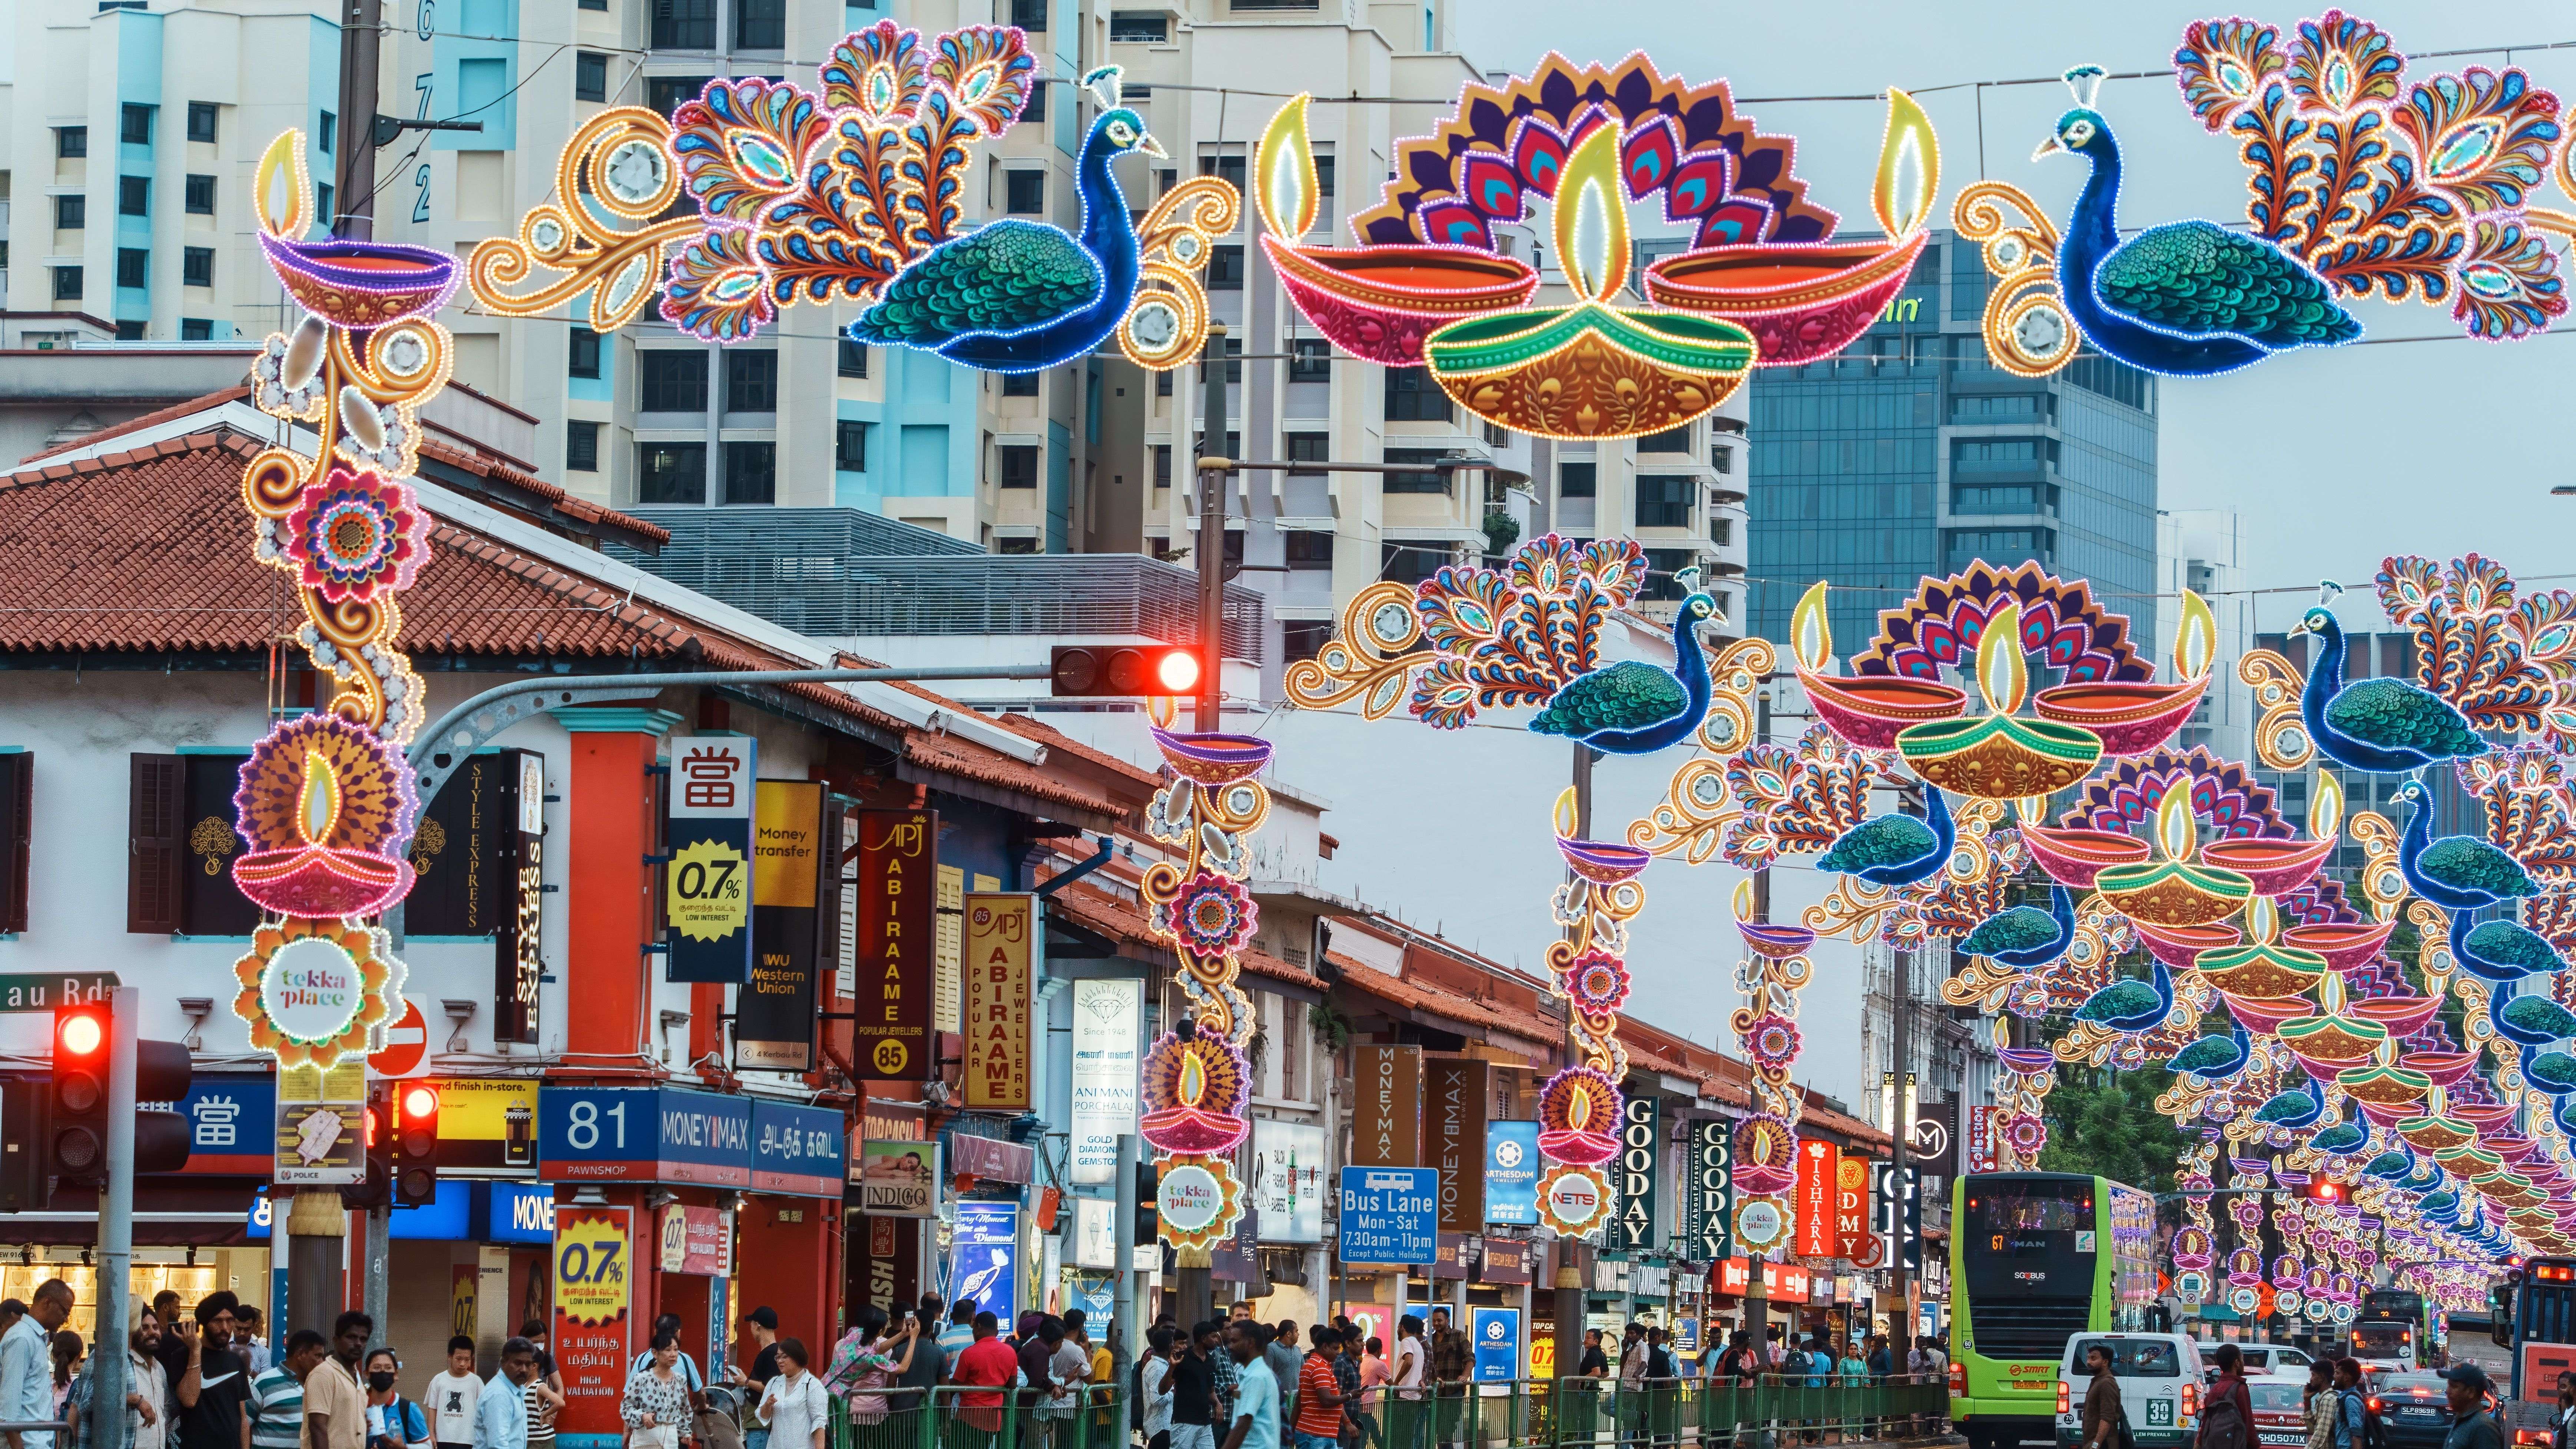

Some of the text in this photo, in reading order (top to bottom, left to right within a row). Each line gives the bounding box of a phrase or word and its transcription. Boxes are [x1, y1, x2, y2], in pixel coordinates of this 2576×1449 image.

[682, 746, 740, 807] 當
[470, 763, 482, 830] STYLE
[759, 827, 806, 840] Money
[755, 845, 810, 857] transfer
[468, 835, 481, 928] EXPRESS
[975, 910, 988, 922] 85
[517, 868, 530, 1003] STYLE
[527, 841, 541, 1032] EXPRESS
[883, 859, 903, 1021] ABIRAAME
[281, 969, 346, 989] tekka
[757, 982, 795, 995] Union
[64, 978, 102, 1006] Rd
[280, 989, 344, 1009] place
[972, 968, 981, 1068] POPULAR
[986, 947, 1009, 1099] ABIRAAME
[859, 1027, 922, 1037] POPULAR JEWELLERS
[1014, 969, 1025, 1099] JEWELLERS
[878, 1046, 902, 1067] 85
[439, 1081, 526, 1092] nd finish in-store.
[1075, 1087, 1133, 1098] ANI MANI
[1074, 1101, 1133, 1111] PORCHALAI
[1377, 1048, 1394, 1159] MONEYMAX
[193, 1095, 240, 1145] 當
[567, 1101, 625, 1150] 81
[1970, 1107, 1984, 1173] Collection
[568, 1166, 626, 1175] PAWNSHOP
[1486, 1170, 1534, 1178] ARTHESDAM
[1624, 1100, 1654, 1244] GOODAY
[866, 1187, 926, 1205] INDIGO
[1169, 1185, 1210, 1198] tekka
[1553, 1192, 1595, 1205] NETS
[1703, 1123, 1729, 1258] GOODAY
[1168, 1198, 1210, 1210] place
[1345, 1190, 1433, 1213] Bus Lane
[1809, 1159, 1823, 1254] ISHTARA
[513, 1195, 554, 1230] MONE
[975, 1214, 1009, 1223] Moment
[1746, 1222, 1773, 1230] place
[1839, 1193, 1860, 1256] DMY
[974, 1233, 1015, 1242] Diamond
[1992, 1235, 2003, 1250] 67
[1348, 1249, 1428, 1260] Except Public Holidays
[1596, 1260, 1618, 1292] GOODAY
[1638, 1265, 1661, 1296] GOODAY
[870, 1260, 894, 1323] ASH
[580, 1375, 601, 1385] HIGH
[566, 1387, 614, 1396] VALUATION
[2150, 1403, 2169, 1420] 30
